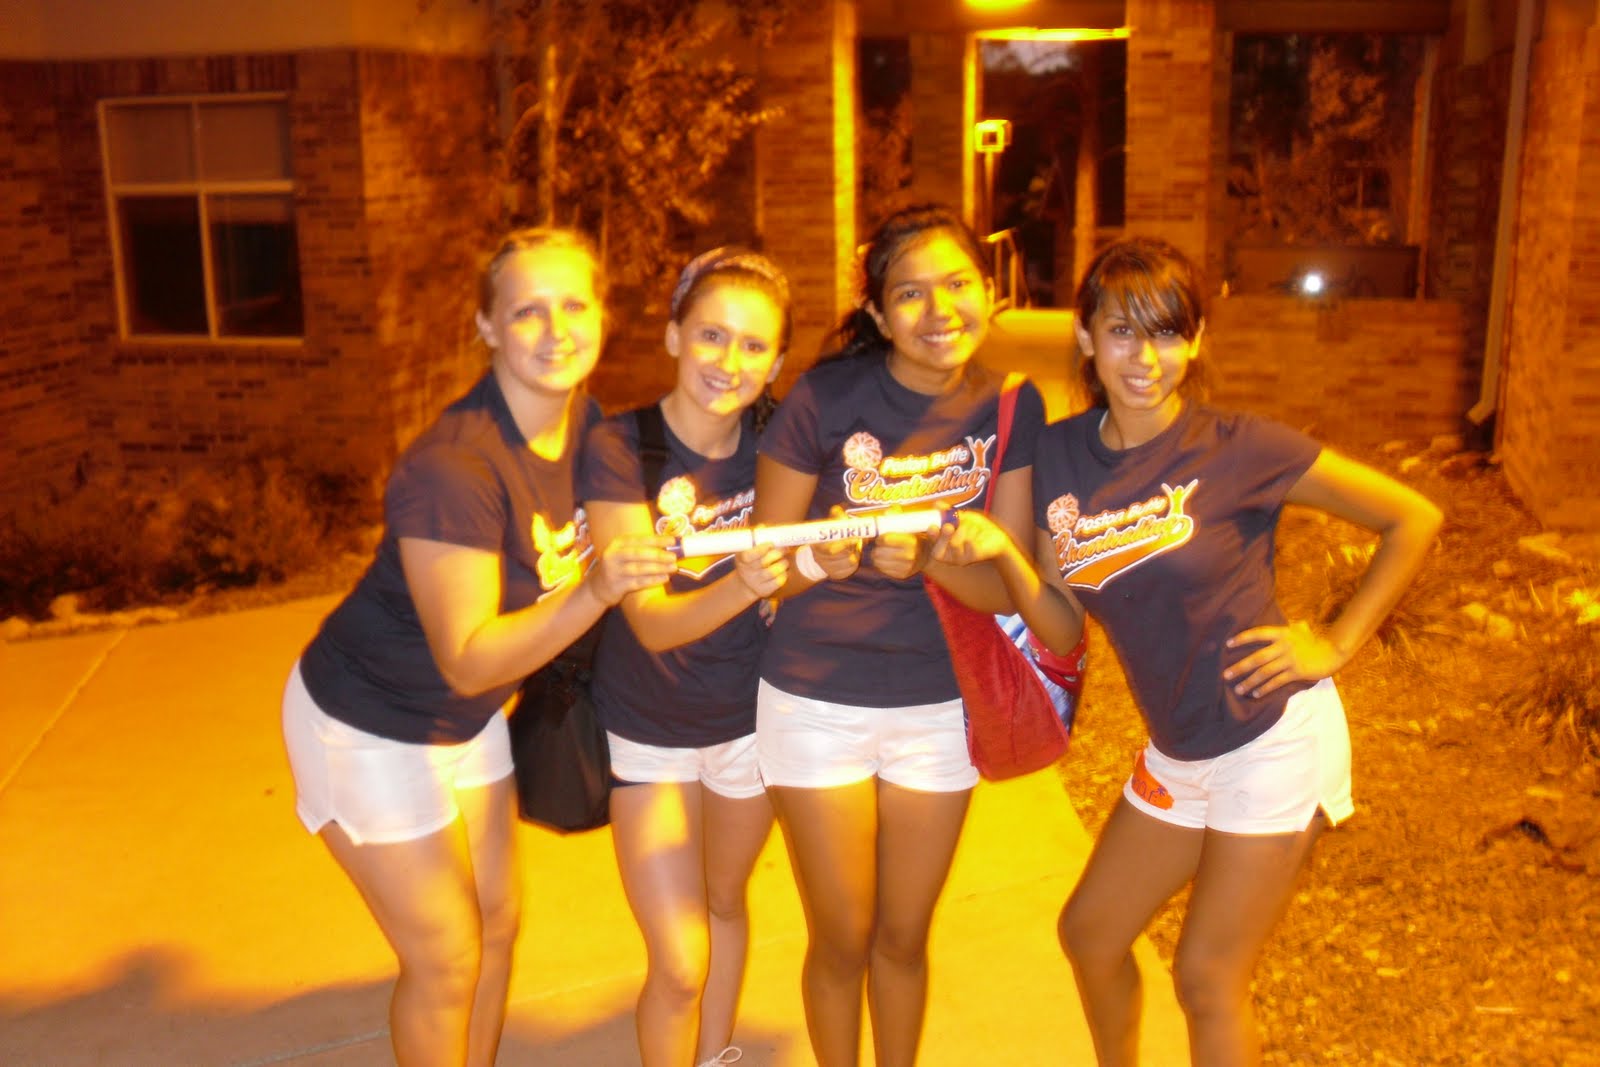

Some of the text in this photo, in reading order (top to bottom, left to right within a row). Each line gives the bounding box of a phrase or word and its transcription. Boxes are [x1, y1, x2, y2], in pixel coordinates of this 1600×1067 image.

[931, 447, 968, 469] Butte
[845, 466, 991, 503] Cheerleading
[818, 525, 870, 540] SPIRIT
[1074, 512, 1125, 533] Poston
